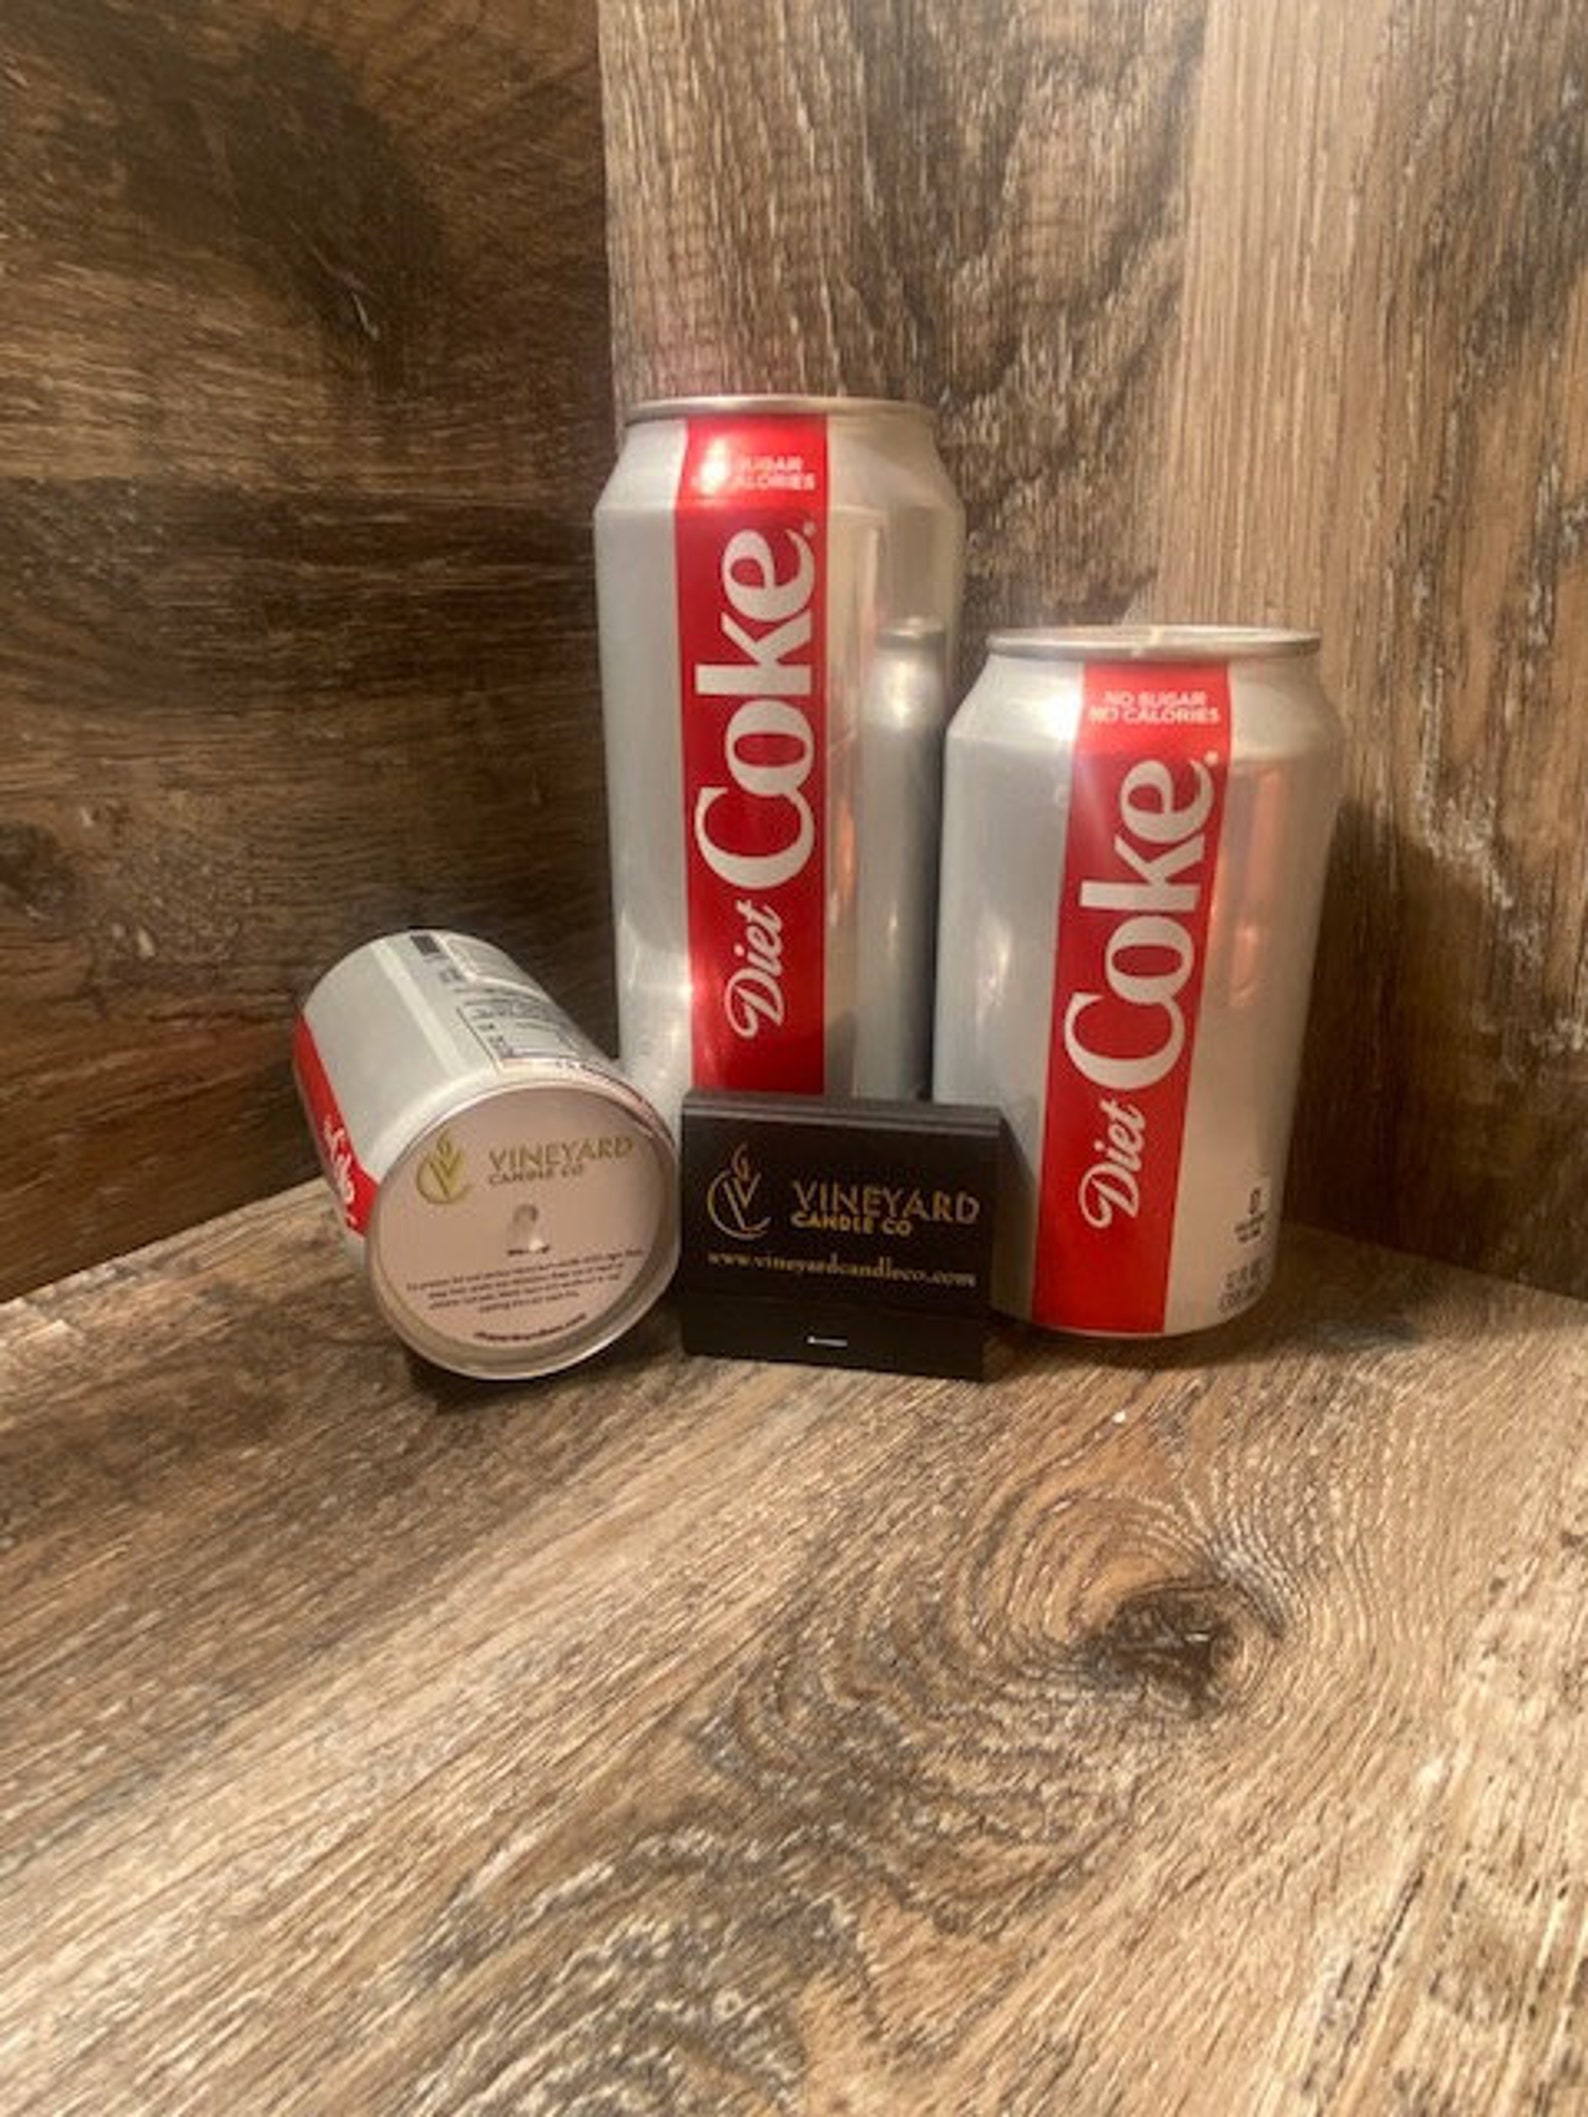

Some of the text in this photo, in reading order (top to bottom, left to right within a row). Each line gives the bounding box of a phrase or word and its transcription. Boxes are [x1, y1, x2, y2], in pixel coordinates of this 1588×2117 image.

[694, 529, 815, 889] Coke
[1090, 706, 1219, 725] NO CALORIES
[1104, 690, 1207, 707] NO SUGAR
[725, 899, 785, 1038] Diet
[1064, 758, 1215, 1228] Diet Coke
[488, 1137, 634, 1173] VINEYARD
[488, 1164, 555, 1185] CANDLE
[793, 1180, 980, 1225] VINEYARD
[791, 1212, 913, 1237] CANDLE CO
[706, 1252, 978, 1288] www.vineyardcandleco.com
